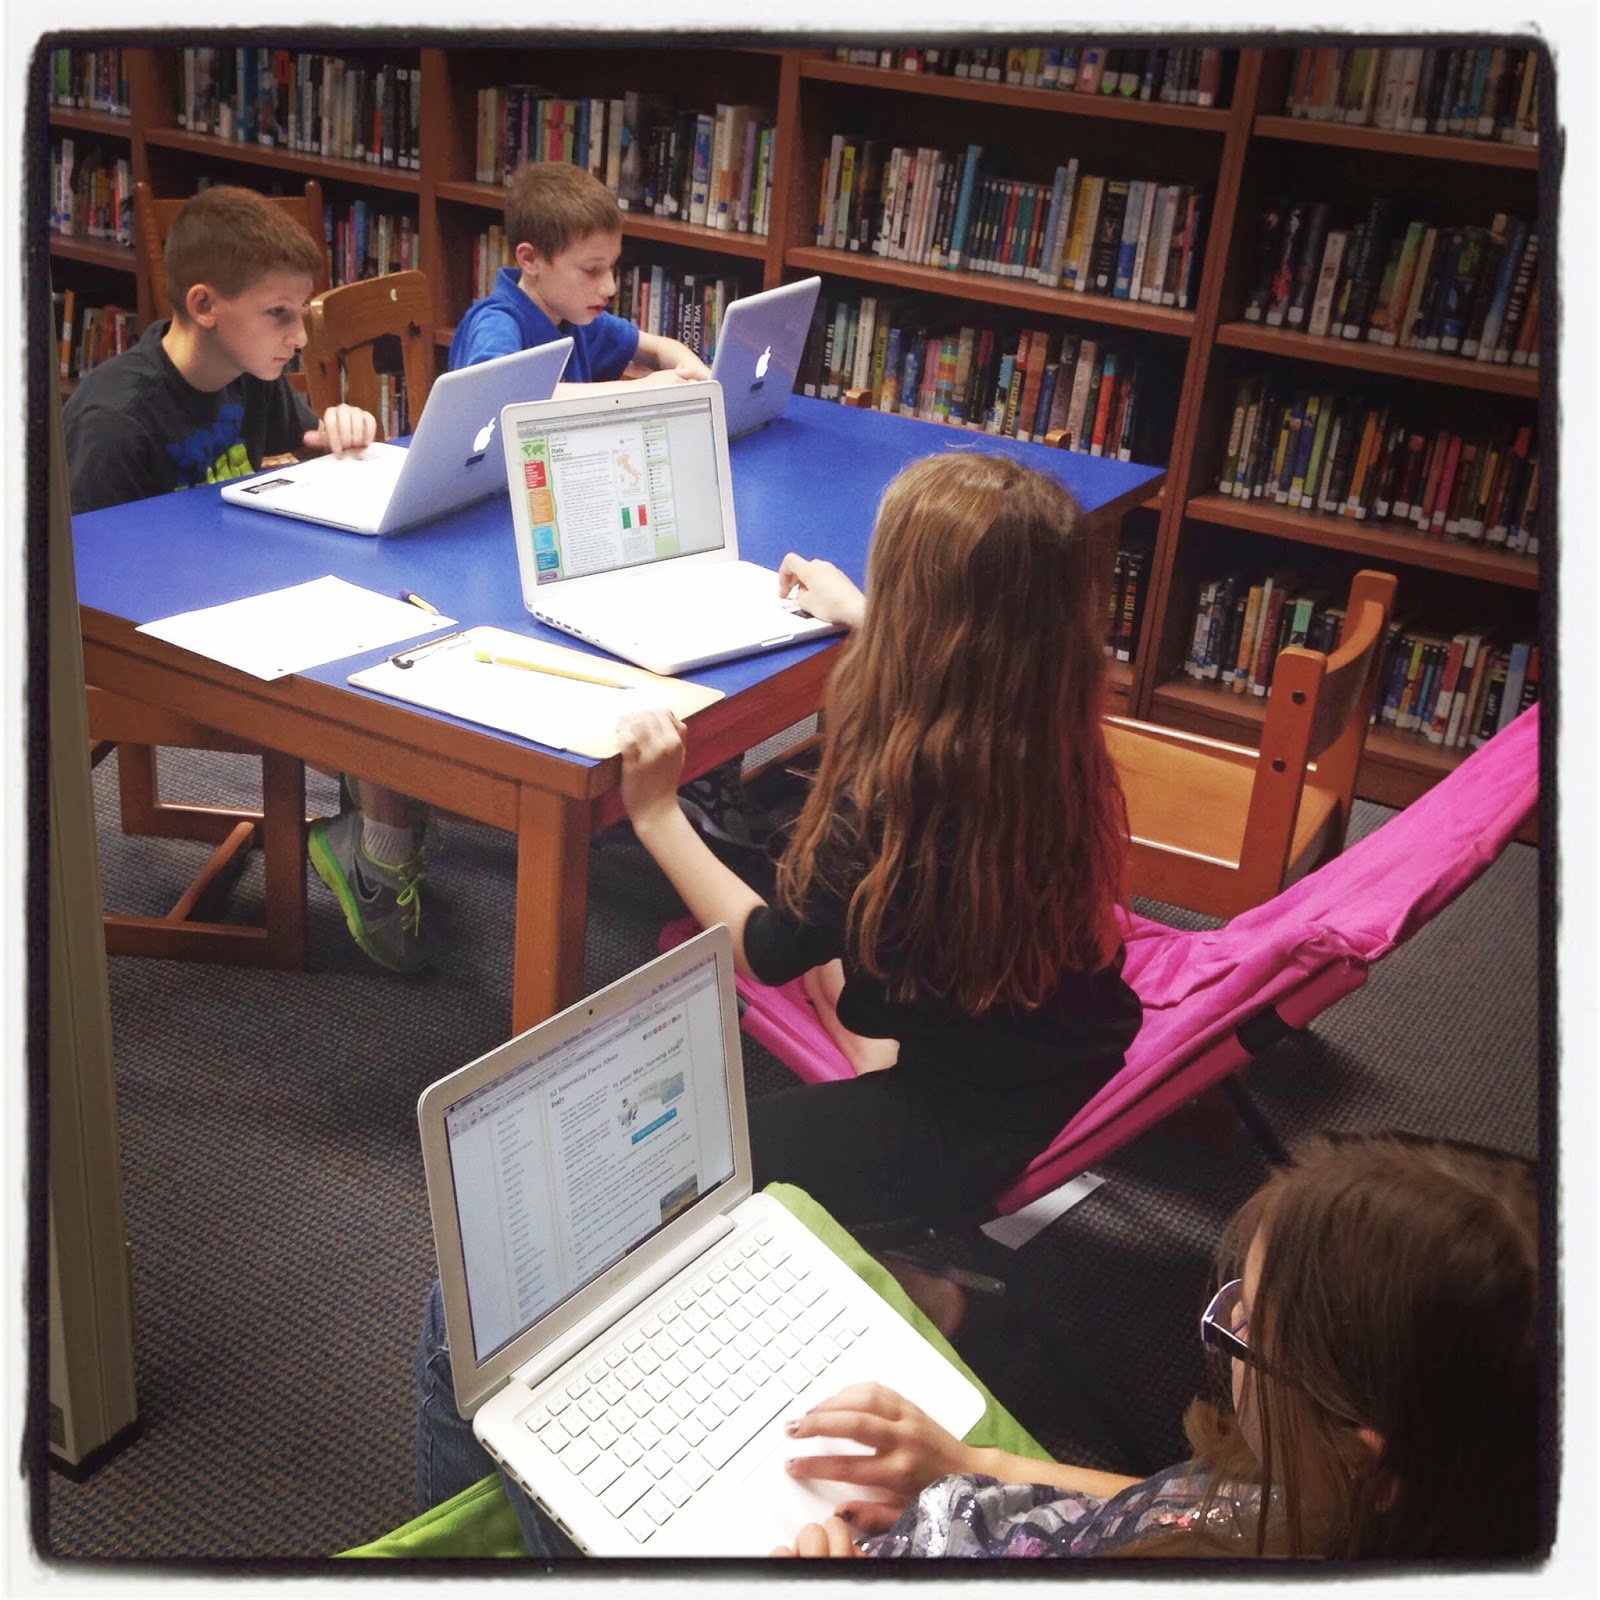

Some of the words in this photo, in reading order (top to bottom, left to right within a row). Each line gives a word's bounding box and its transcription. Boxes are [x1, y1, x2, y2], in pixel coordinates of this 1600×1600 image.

[693, 304, 701, 353] WILLOW
[827, 324, 835, 338] THE
[824, 341, 833, 367] WHITE
[1125, 595, 1135, 610] RISE
[558, 1073, 586, 1092] Interesting
[588, 1064, 602, 1074] Facts
[603, 1053, 618, 1064] About
[633, 1065, 644, 1075] Mac
[551, 1097, 565, 1108] Italy
